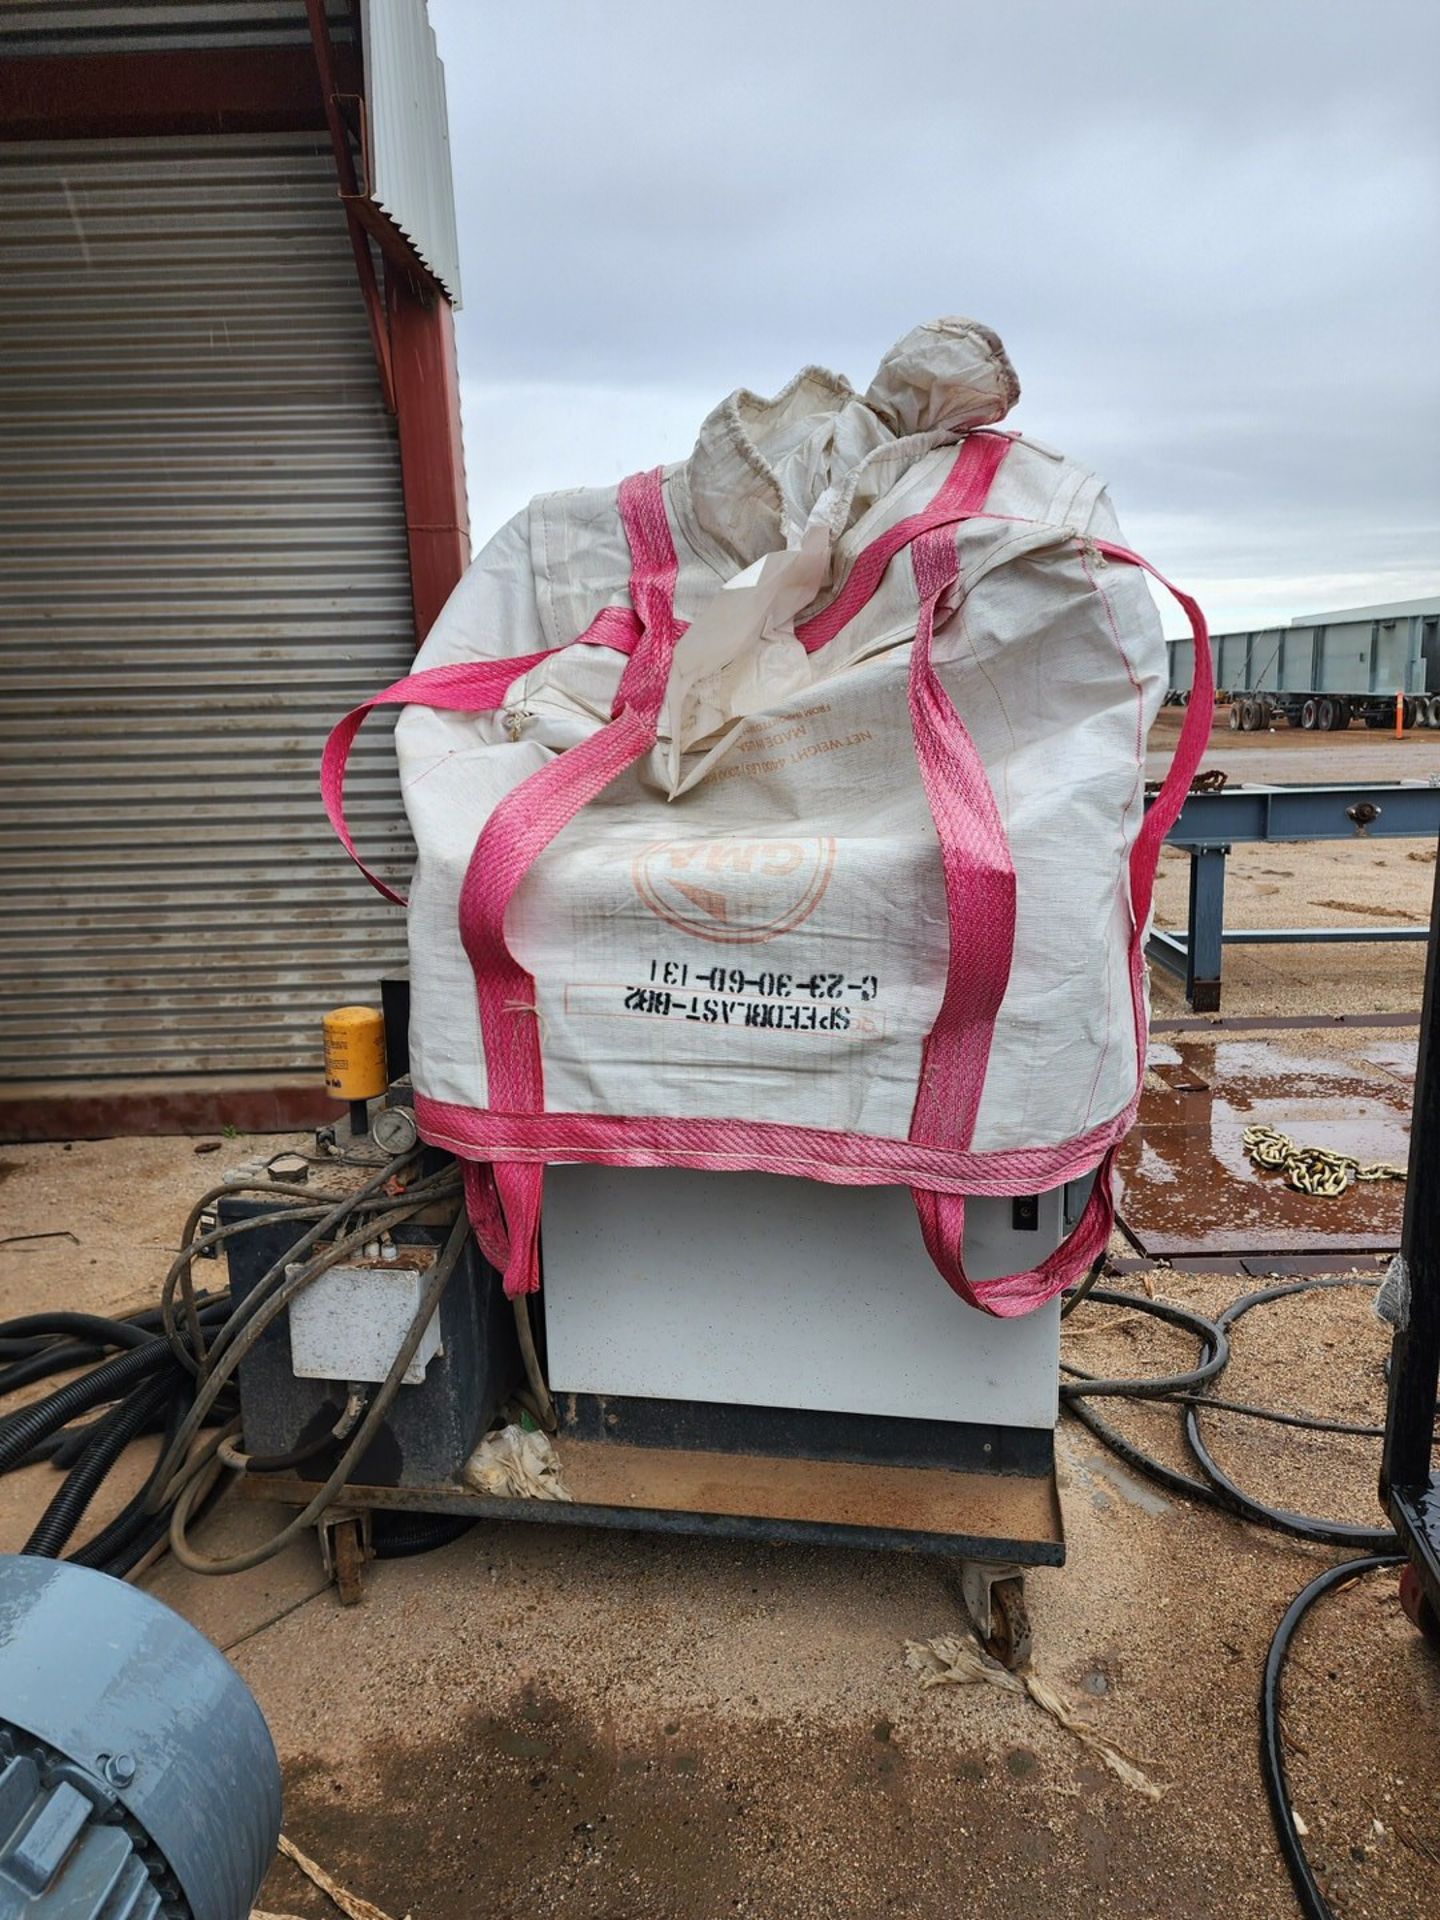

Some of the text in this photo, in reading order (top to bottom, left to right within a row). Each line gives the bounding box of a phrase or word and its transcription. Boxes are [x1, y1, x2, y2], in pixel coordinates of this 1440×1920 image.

[804, 704, 831, 717] FROM
[765, 724, 808, 747] MADE
[845, 730, 873, 746] NET
[789, 737, 845, 763] WEIGHT
[667, 843, 805, 876] GMA
